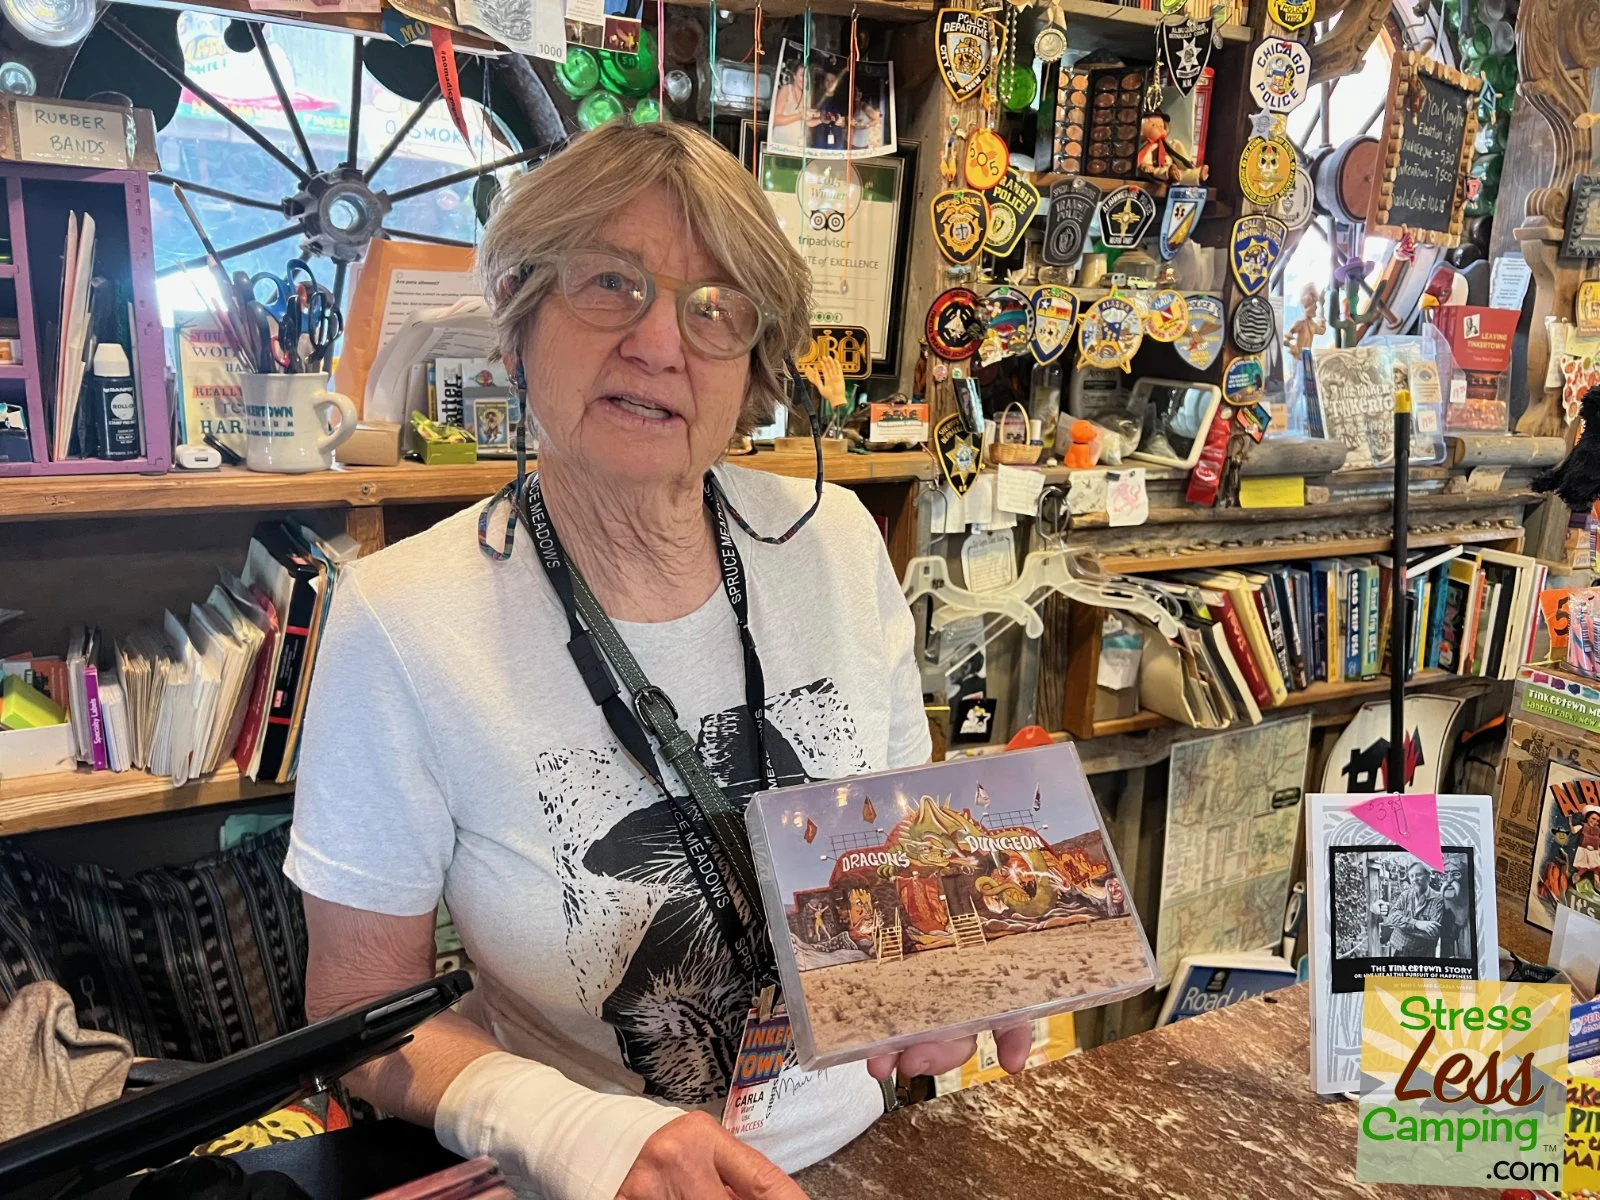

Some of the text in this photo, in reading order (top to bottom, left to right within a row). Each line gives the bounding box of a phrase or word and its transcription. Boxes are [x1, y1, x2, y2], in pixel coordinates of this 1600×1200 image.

[957, 12, 988, 29] POLICE
[539, 43, 563, 58] 1000
[1257, 41, 1306, 75] CHICAGO
[965, 75, 982, 93] NEW
[1256, 81, 1300, 109] POLICE
[34, 108, 107, 131] RUBBER
[49, 135, 106, 155] BANDS
[992, 186, 1028, 215] POLICE
[998, 175, 1036, 206] RANSIT
[829, 259, 880, 270] EXCELLENCE
[1101, 300, 1131, 312] ALASKA
[1467, 341, 1507, 350] TINKERTOWN
[1481, 332, 1508, 341] LEAVING
[527, 501, 562, 570] MEADOWS
[722, 548, 742, 605] SPRUCE
[1351, 572, 1359, 657] ROAD TRIP USA
[1528, 688, 1587, 714] Tinkertown
[90, 697, 103, 745] Specialty Labels
[842, 833, 1046, 873] DRAGON'S DUNGEON
[684, 831, 731, 909] MEADOWS
[1371, 964, 1473, 974] THE Tinkertown STORY
[1180, 985, 1234, 1012] Road
[734, 1053, 785, 1079] TOWN
[734, 1090, 765, 1108] CARLA
[741, 1118, 765, 1132] ACCESS
